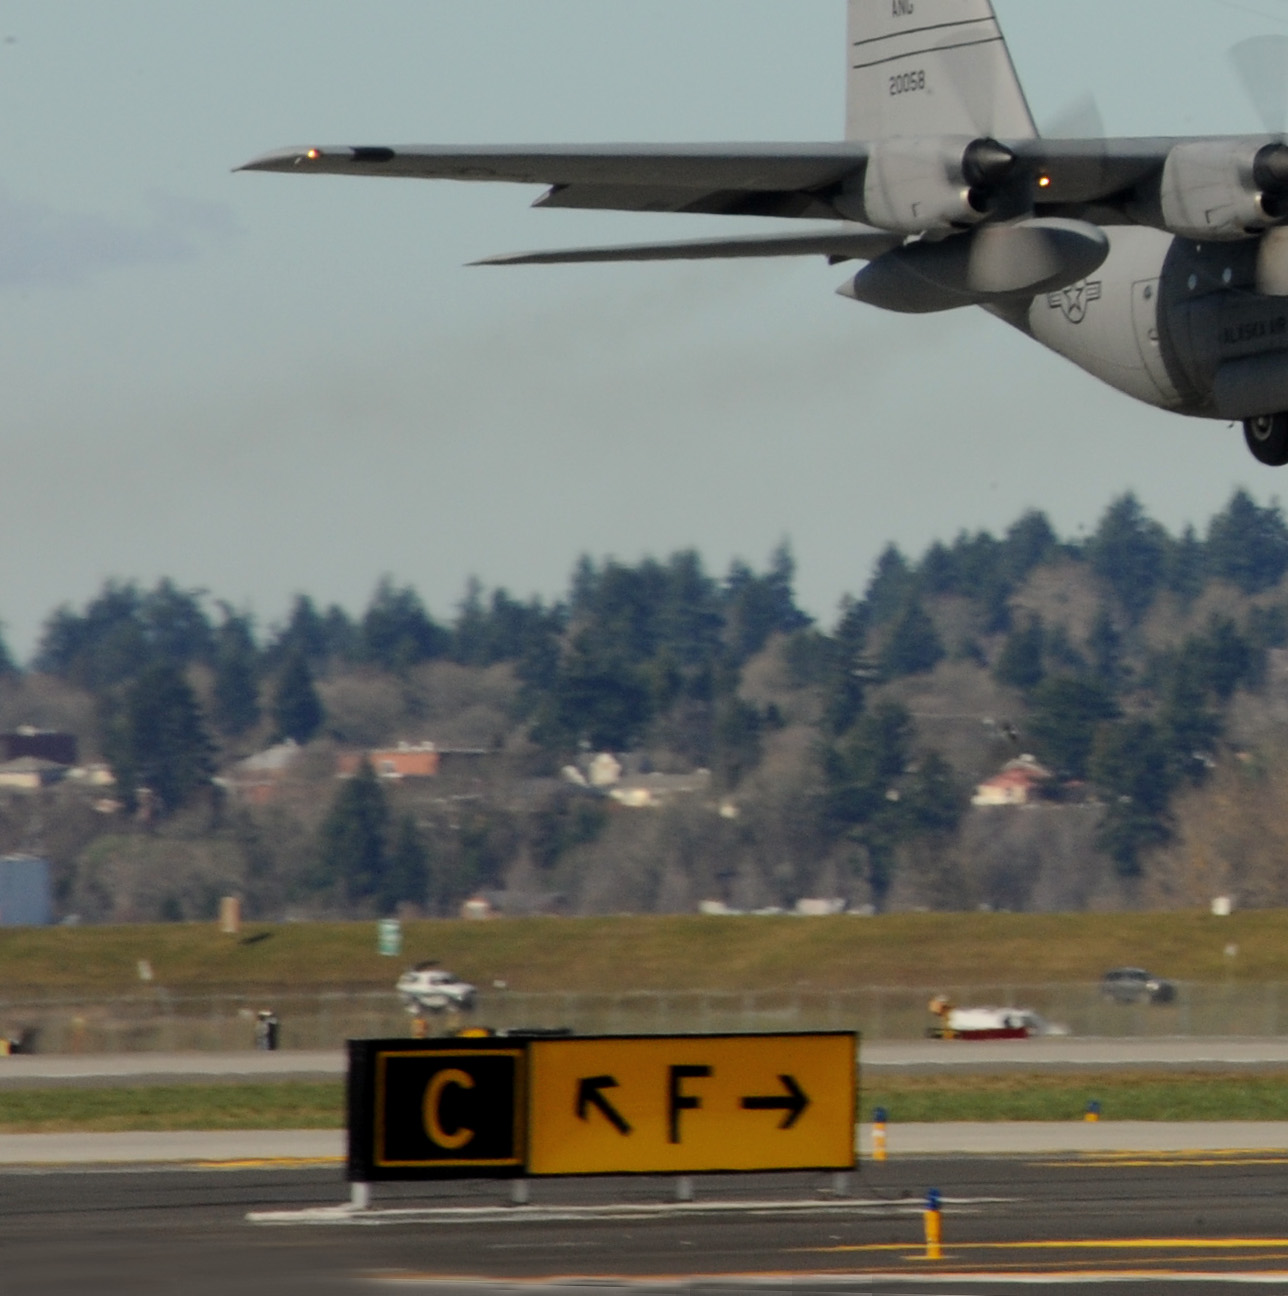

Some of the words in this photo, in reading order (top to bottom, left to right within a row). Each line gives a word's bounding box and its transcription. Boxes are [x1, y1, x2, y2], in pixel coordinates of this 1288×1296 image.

[889, 70, 926, 96] 20058
[422, 1068, 476, 1150] C
[667, 1064, 714, 1145] F
